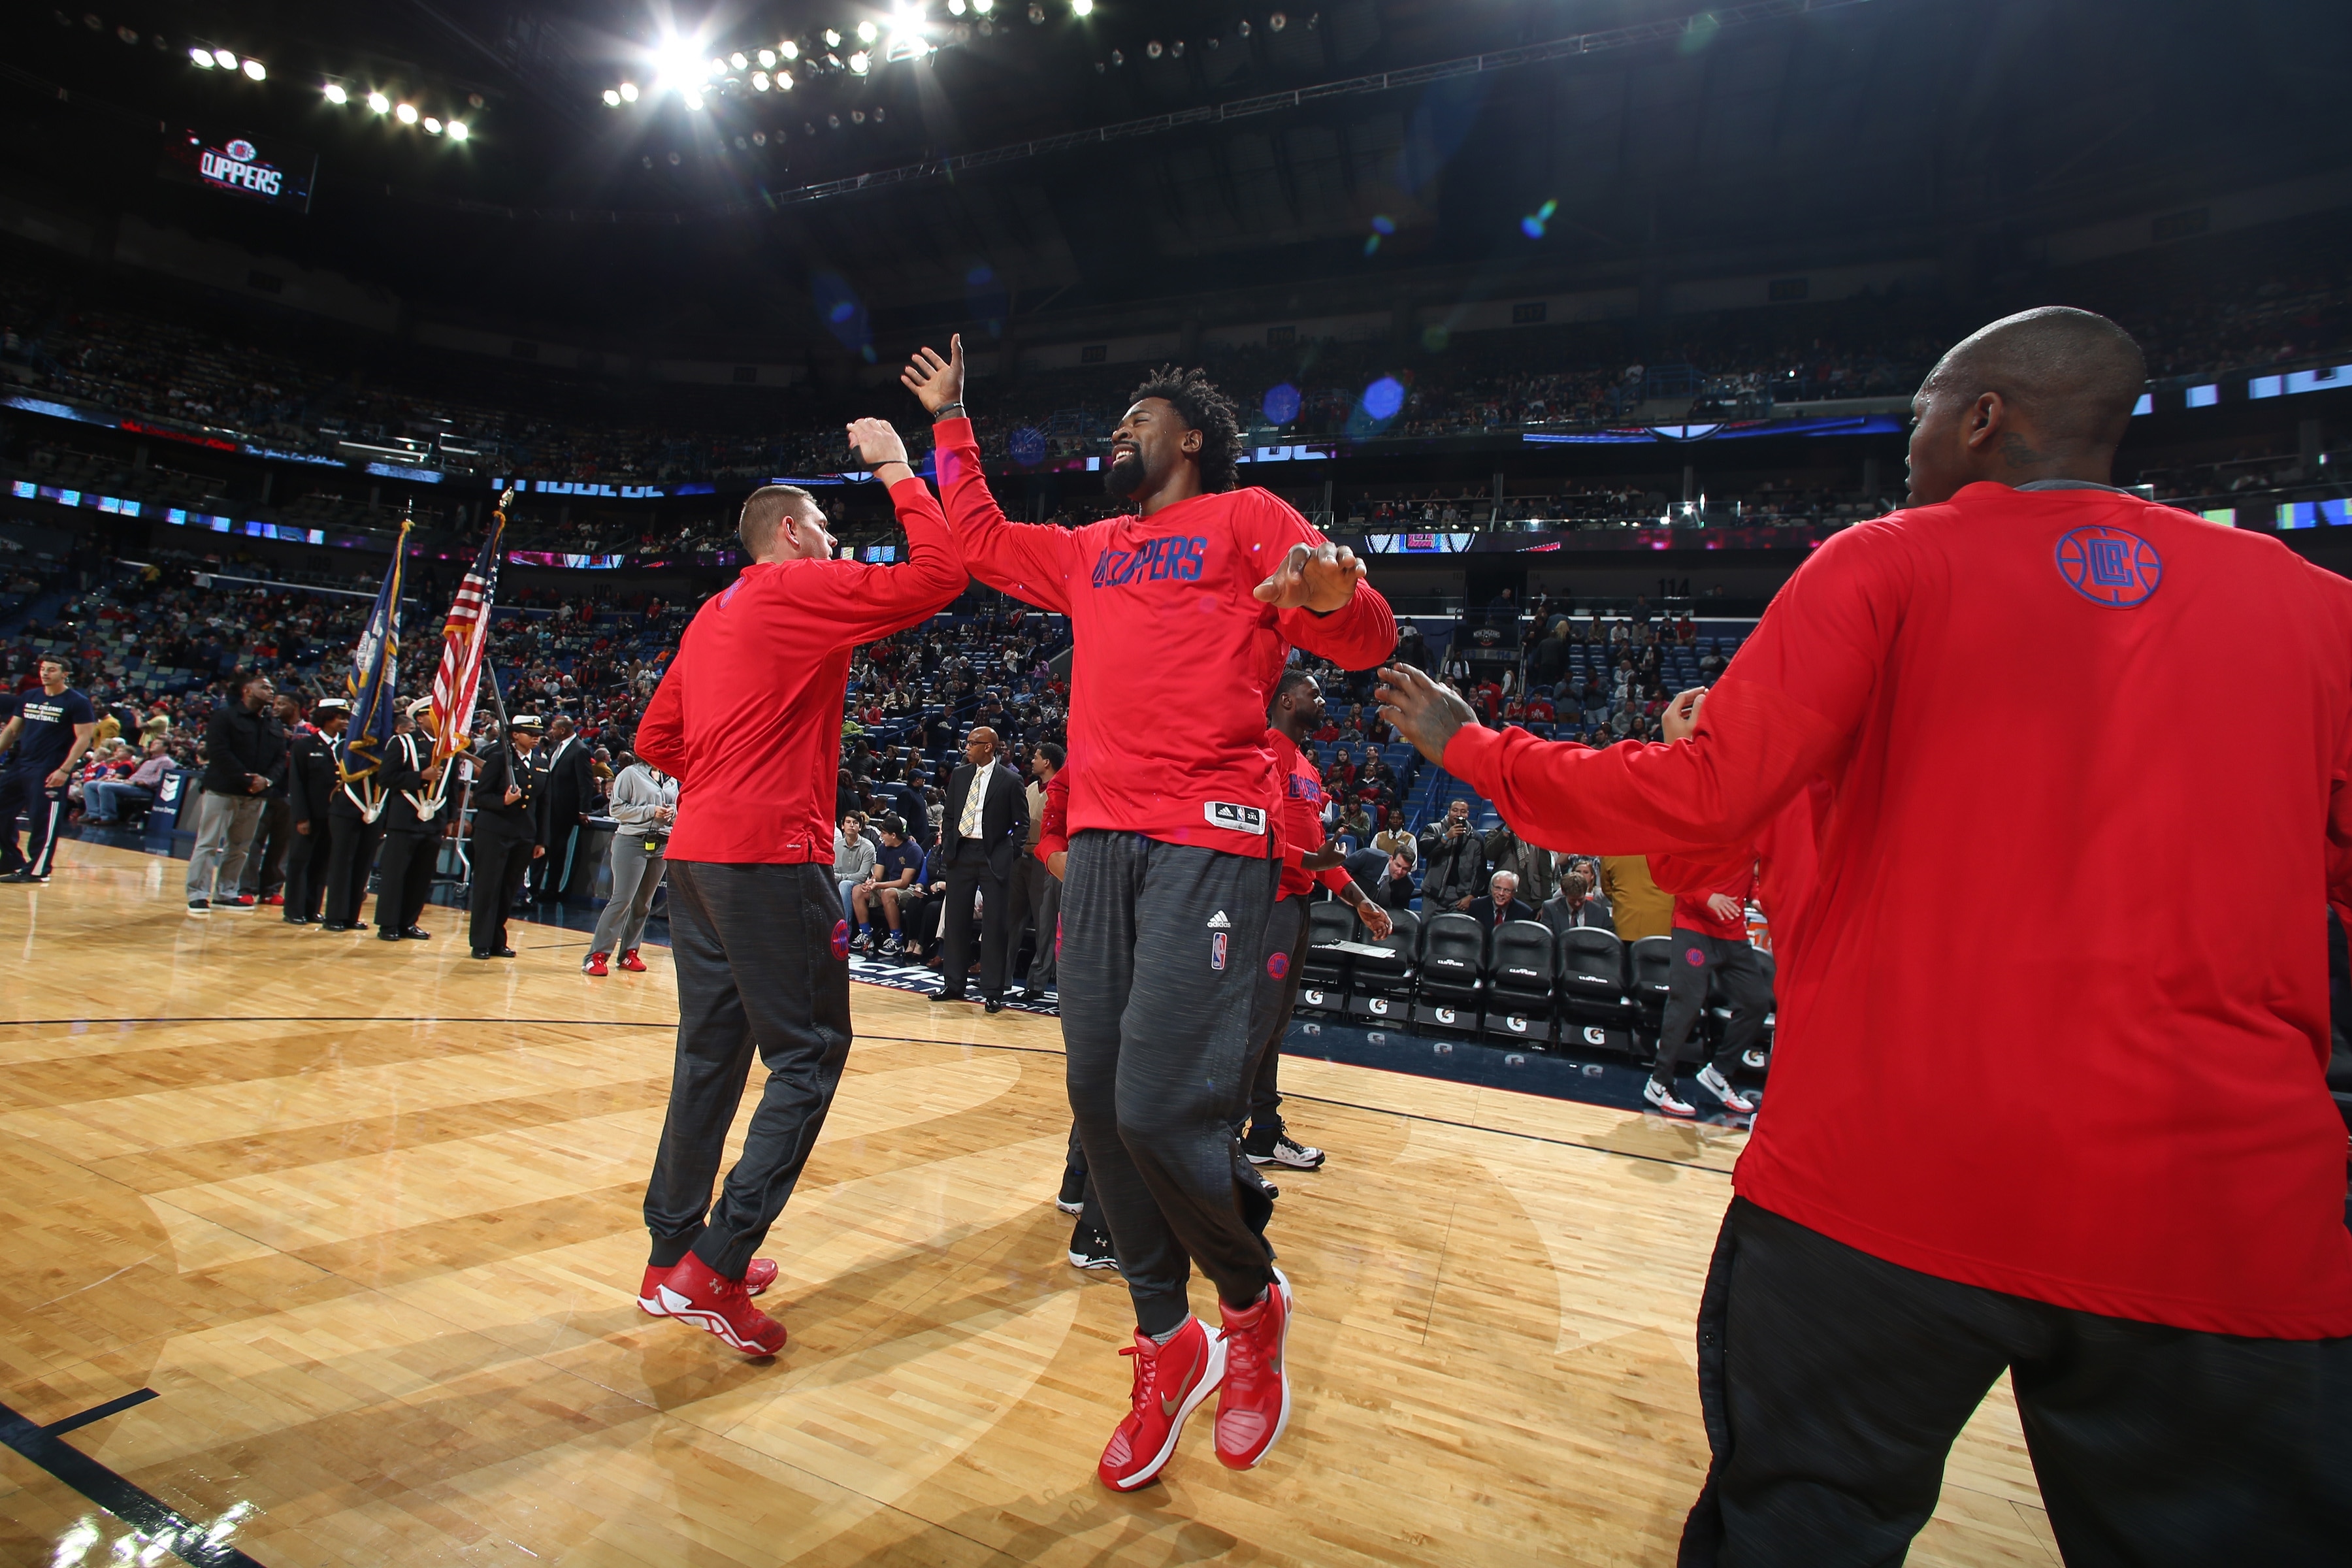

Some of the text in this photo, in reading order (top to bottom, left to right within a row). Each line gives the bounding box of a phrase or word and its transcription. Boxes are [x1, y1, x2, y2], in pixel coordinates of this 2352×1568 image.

[201, 152, 282, 195] CLIPPERS
[1658, 578, 1691, 598] 114
[39, 705, 63, 713] ORLEANS
[849, 973, 915, 989] ealth
